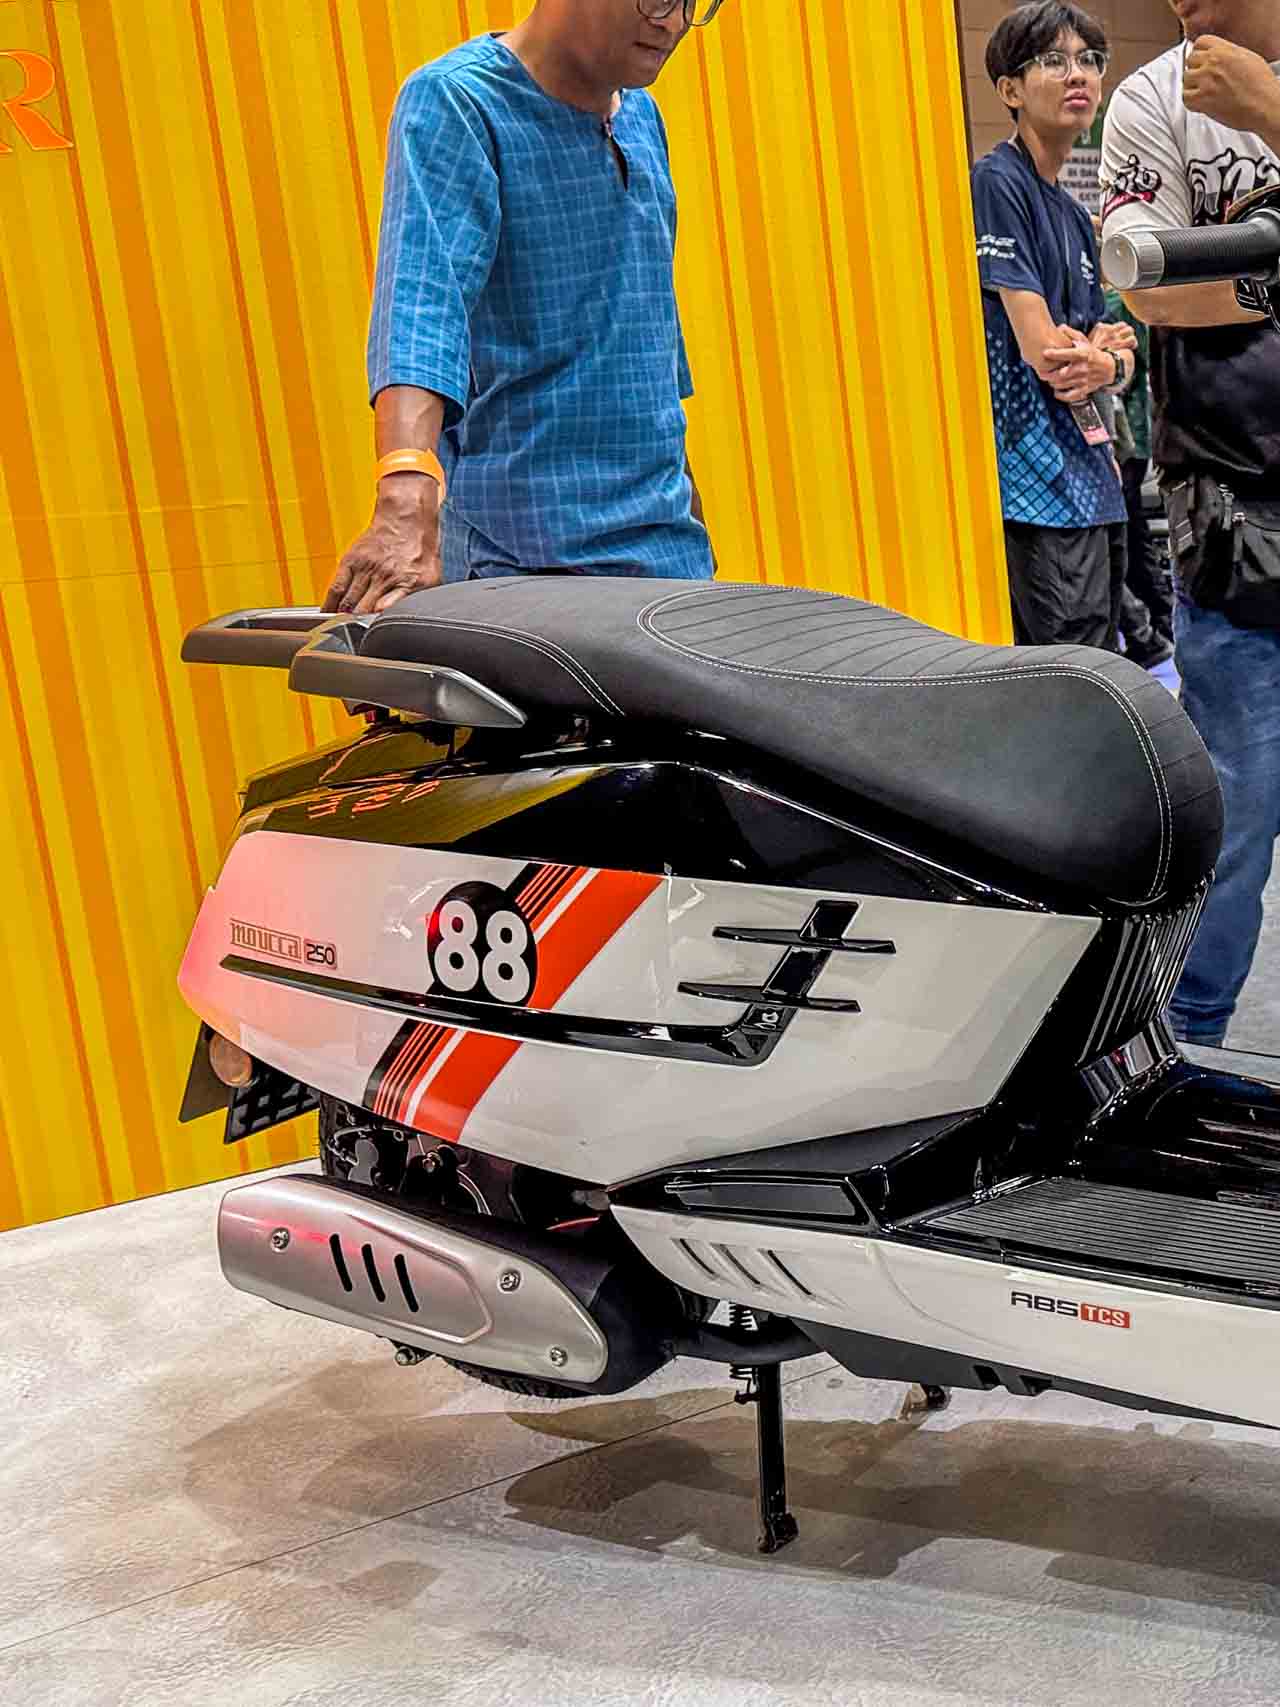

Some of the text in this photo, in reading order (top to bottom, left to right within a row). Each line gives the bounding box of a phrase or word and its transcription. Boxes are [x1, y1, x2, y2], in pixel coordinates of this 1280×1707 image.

[305, 941, 336, 967] 250
[434, 900, 530, 1003] 88
[1010, 1291, 1126, 1327] ABS TCS
